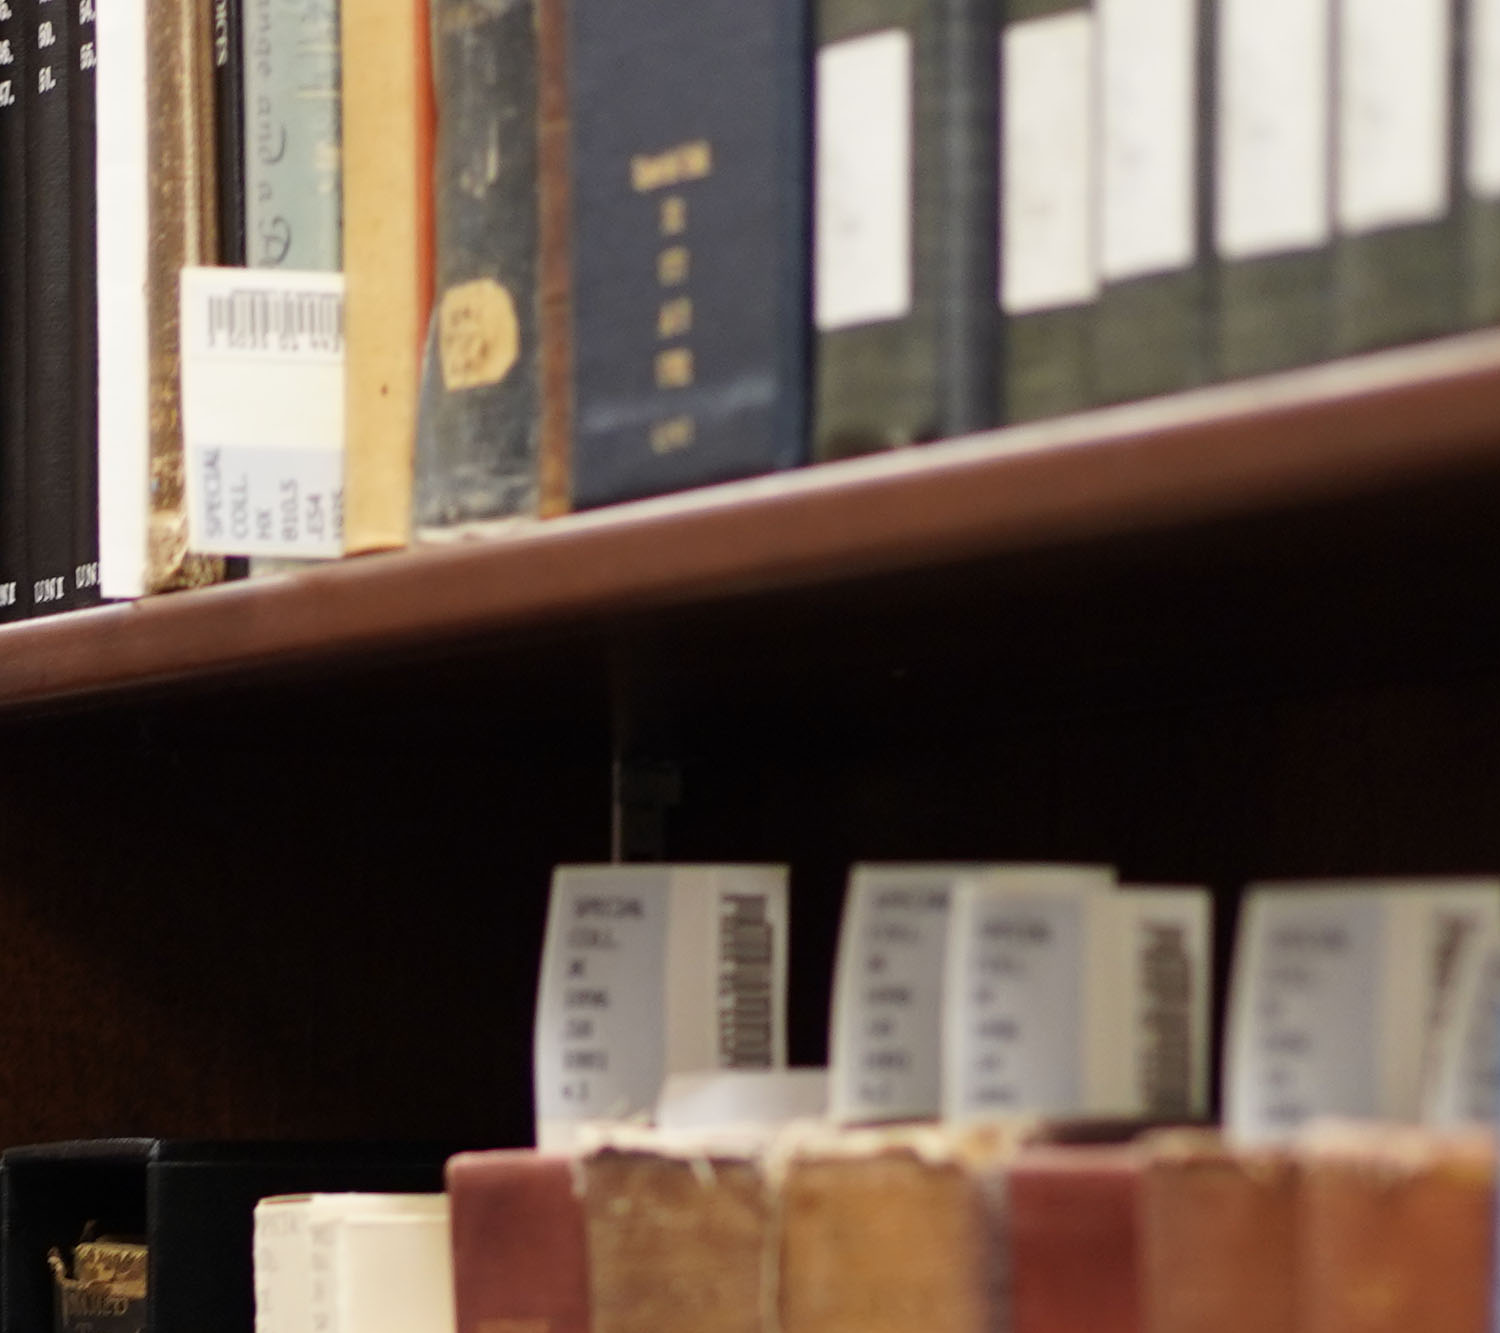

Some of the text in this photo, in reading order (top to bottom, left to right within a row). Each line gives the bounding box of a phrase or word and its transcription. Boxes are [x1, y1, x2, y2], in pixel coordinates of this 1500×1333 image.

[204, 446, 223, 539] SPECIAL
[230, 473, 249, 540] COLL.
[34, 576, 65, 604] UNI
